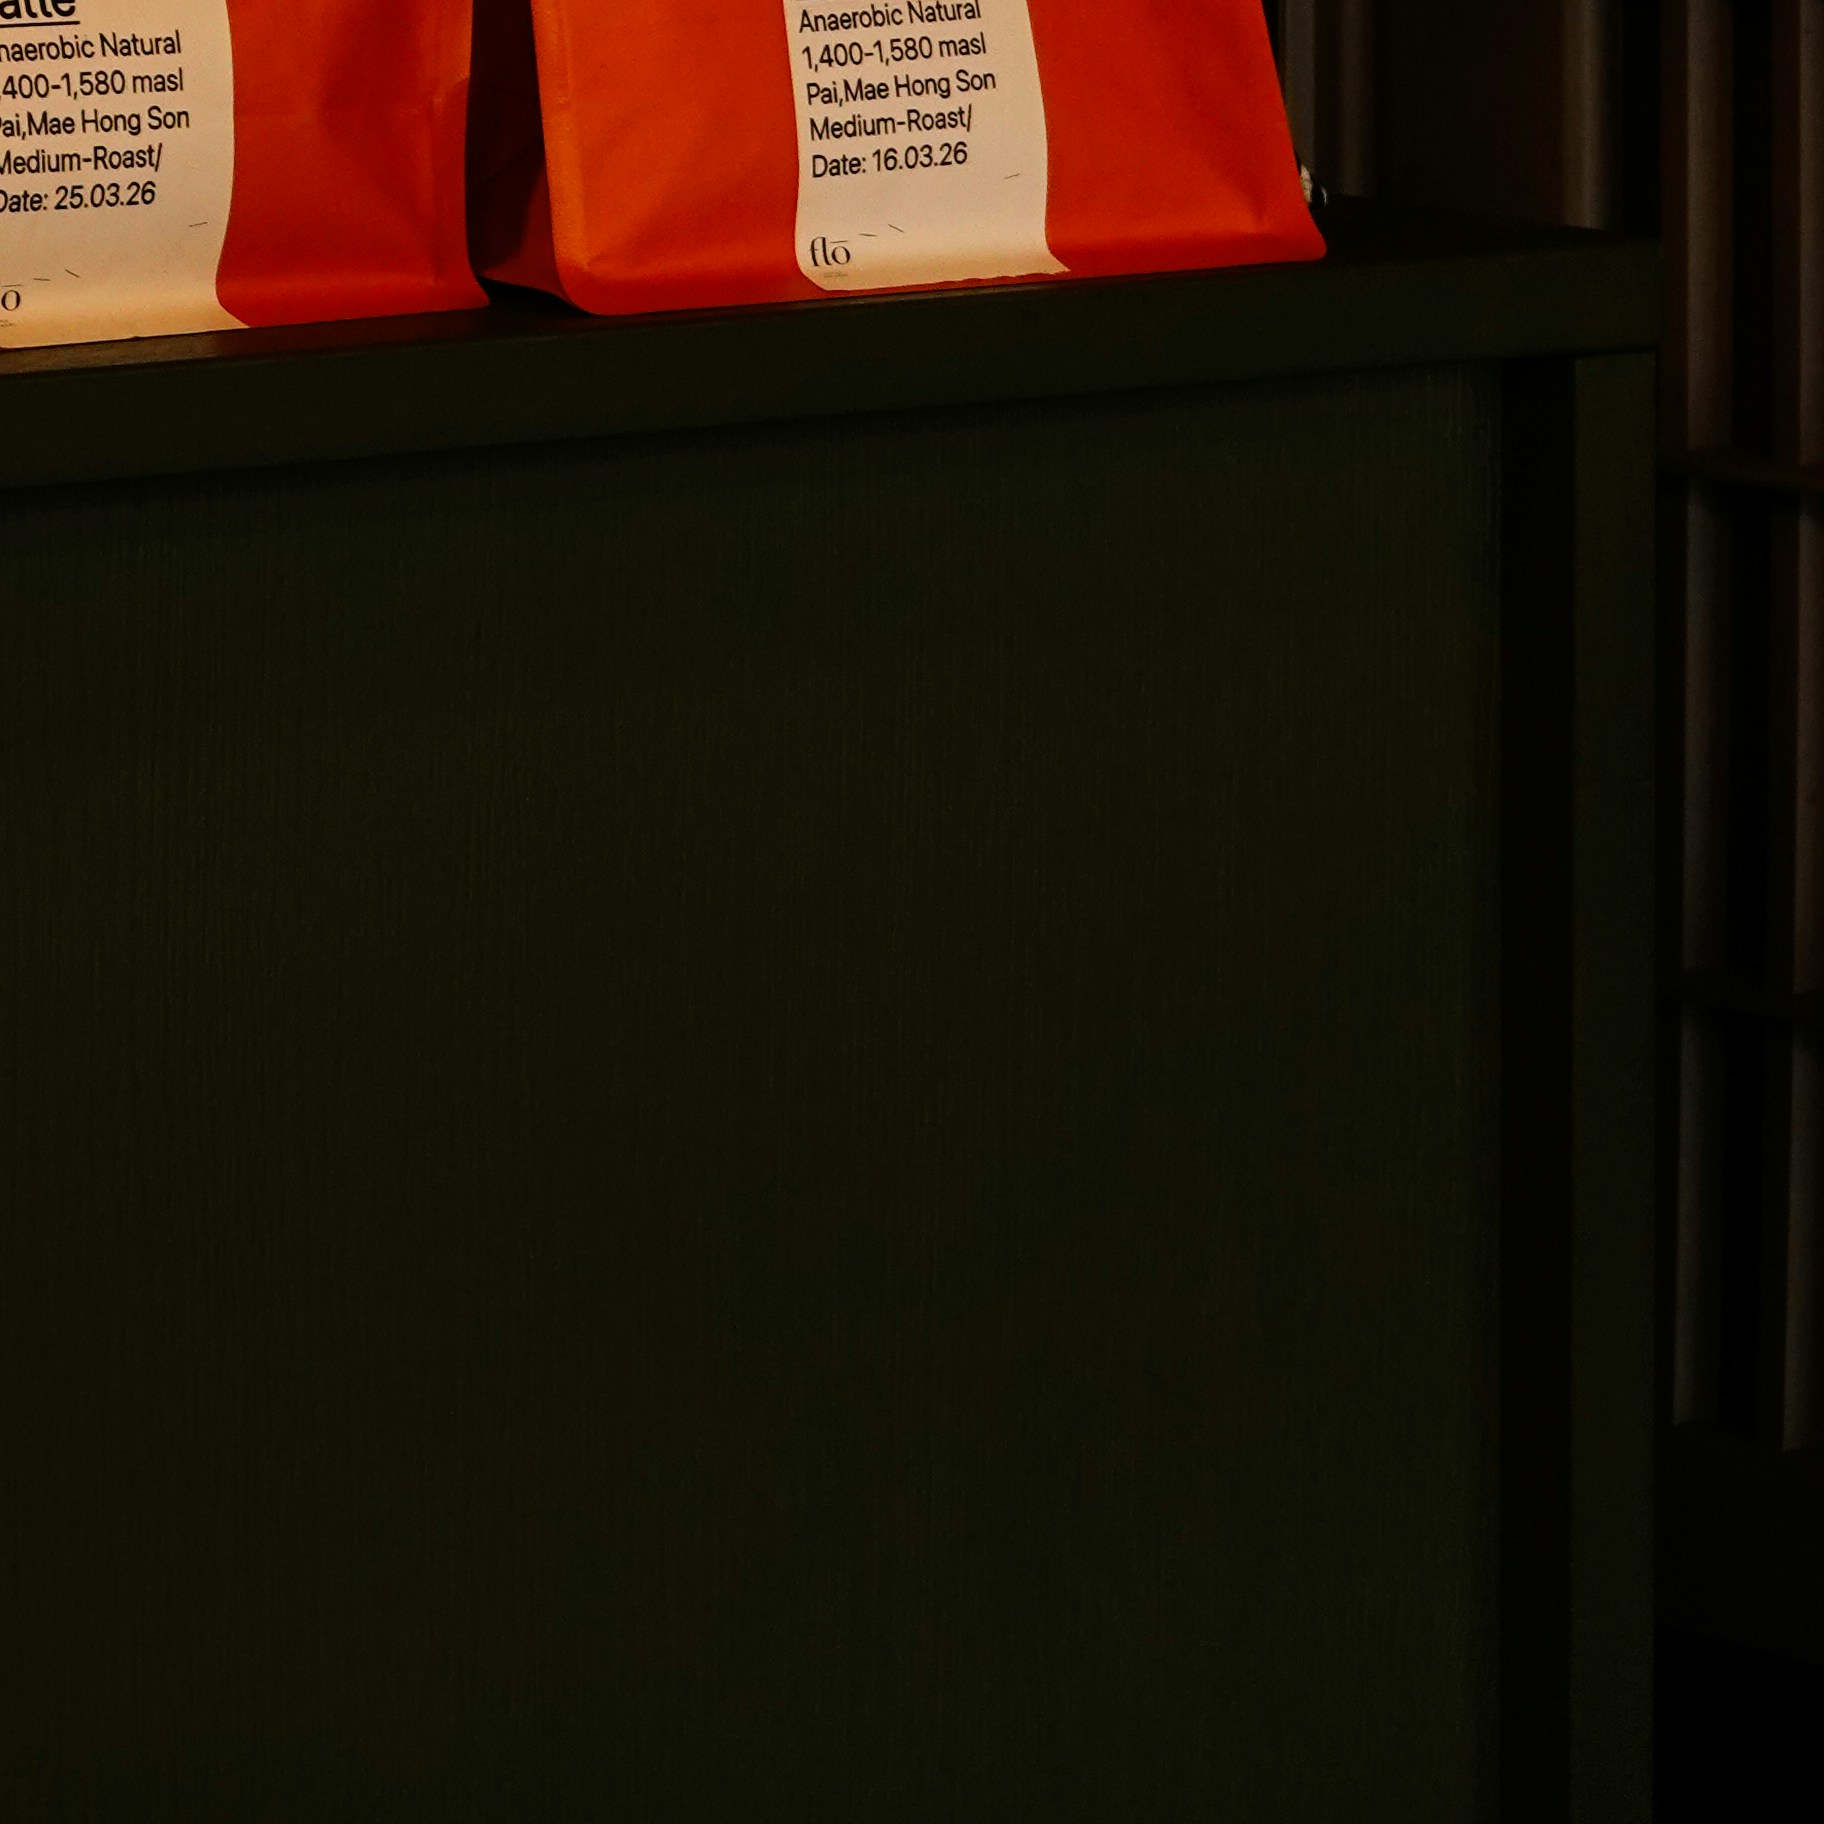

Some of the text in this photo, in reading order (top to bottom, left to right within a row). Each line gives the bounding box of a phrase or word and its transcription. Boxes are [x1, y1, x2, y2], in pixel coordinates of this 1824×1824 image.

[799, 3, 903, 33] Anaerobic
[99, 30, 181, 57] Natural
[802, 32, 986, 72] 1,400-1,580 masl
[133, 67, 183, 93] masl
[807, 69, 996, 107] Pai,Mae Hong Son
[81, 109, 141, 136] Hong
[148, 106, 189, 130] Son
[810, 104, 971, 141] Medium-Roast/
[813, 141, 967, 178] Date: 16.03.26
[54, 181, 156, 210] 25.03.26
